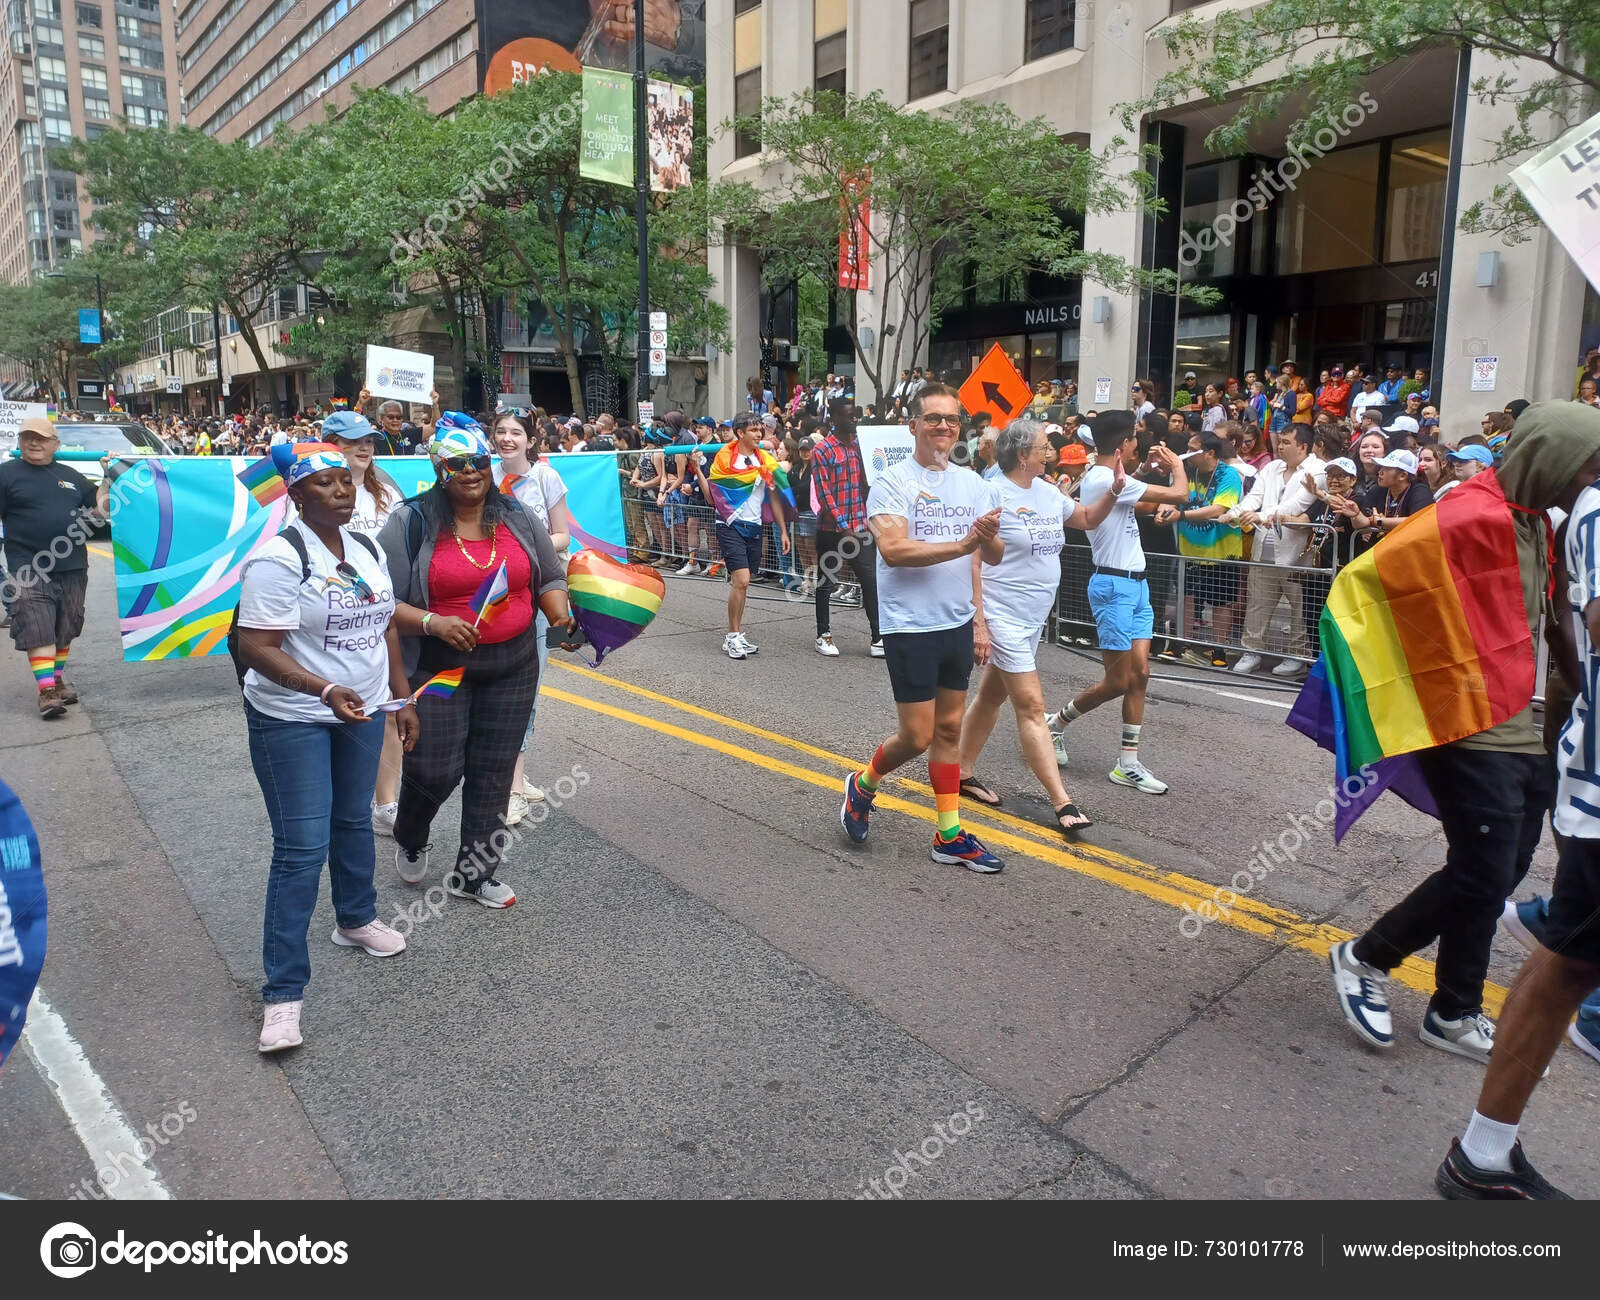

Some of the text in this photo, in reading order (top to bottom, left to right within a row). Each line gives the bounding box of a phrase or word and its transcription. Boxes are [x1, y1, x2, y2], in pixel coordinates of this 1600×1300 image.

[595, 113, 619, 124] MEET
[608, 125, 619, 134] IN
[584, 150, 615, 161] HEART
[1415, 270, 1438, 288] 41
[1025, 306, 1068, 325] NAILS
[168, 383, 181, 391] 40
[884, 446, 912, 454] RAINBOW
[886, 453, 906, 461] SAUGA
[915, 503, 976, 518] Rainbow
[347, 517, 387, 532] ainbo
[915, 520, 951, 536] Faith
[1028, 528, 1054, 541] Faith
[1031, 541, 1064, 556] Freedo
[325, 610, 393, 631] Faith an
[323, 629, 383, 652] Freed
